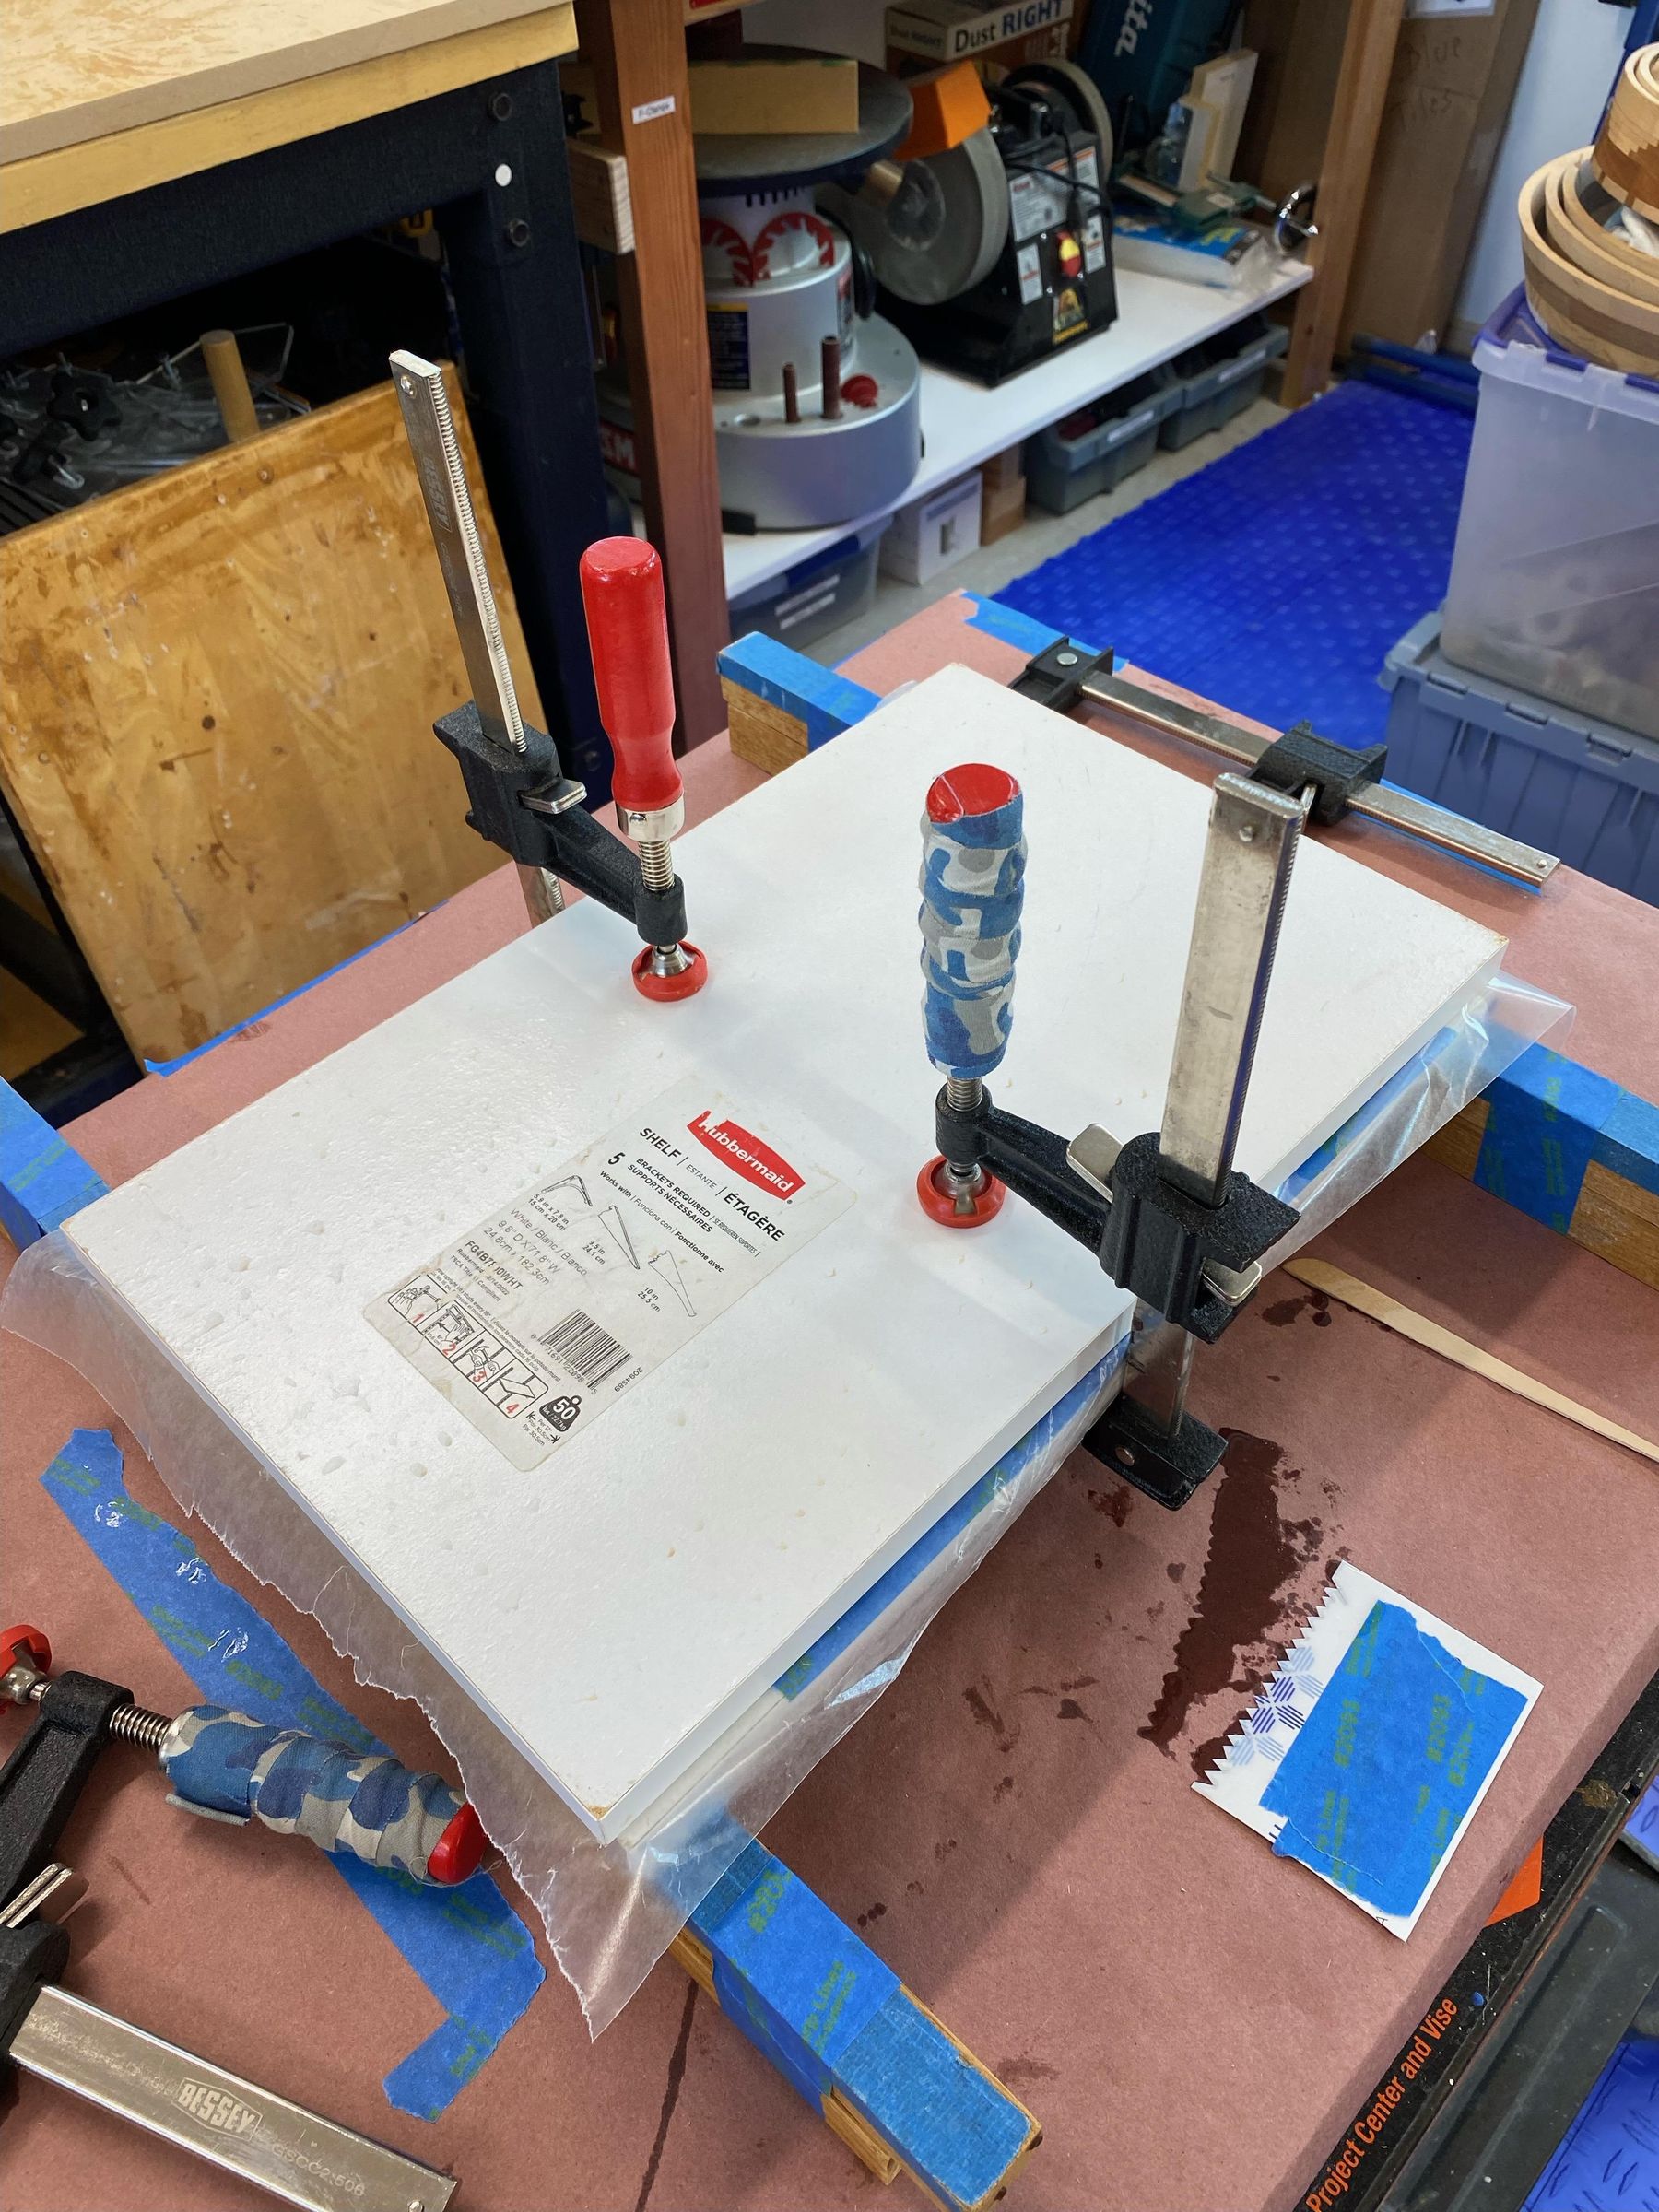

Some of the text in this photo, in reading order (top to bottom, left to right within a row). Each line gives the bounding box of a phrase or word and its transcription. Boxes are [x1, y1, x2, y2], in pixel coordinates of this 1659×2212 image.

[955, 23, 996, 52] Dust
[1003, 0, 1061, 34] RIGHT
[608, 1152, 626, 1165] 5
[628, 1164, 665, 1194] SUPPORTS
[636, 1158, 674, 1188] BRACKETS
[673, 1187, 711, 1218] REQUIRED
[640, 1127, 682, 1159] SHELF
[686, 1164, 718, 1189] ESTANTE
[724, 1192, 785, 1241] ÉTAGÈRE
[528, 1198, 535, 1207] 15
[535, 1205, 546, 1214] cm
[548, 1215, 558, 1224] 20
[556, 1221, 567, 1231] cm
[553, 1209, 564, 1219] 7.8
[562, 1217, 570, 1225] in
[600, 1171, 618, 1187] Works
[618, 1185, 632, 1197] with
[634, 1198, 661, 1222] Funciona
[660, 1219, 673, 1231] con
[675, 1231, 709, 1260] Fonctionne
[708, 1258, 724, 1273] avec
[511, 1208, 533, 1229] White
[535, 1230, 559, 1251] Blanc
[560, 1253, 588, 1277] Blanco
[513, 1232, 524, 1241] D
[549, 1263, 560, 1274] W
[594, 1254, 606, 1265] cm
[477, 1280, 501, 1302] Compliant
[638, 1292, 661, 1312] 25.5 cm
[644, 1287, 659, 1300] 10 in
[413, 1312, 425, 1323] 1
[442, 1343, 456, 1356] 2
[473, 1371, 487, 1382] 3
[614, 1367, 643, 1392] 2094589
[506, 1404, 520, 1414] 4
[553, 1398, 577, 1420] 50
[178, 2082, 255, 2134] BESSEY
[1305, 1998, 1458, 2212] Project Center and Vise
